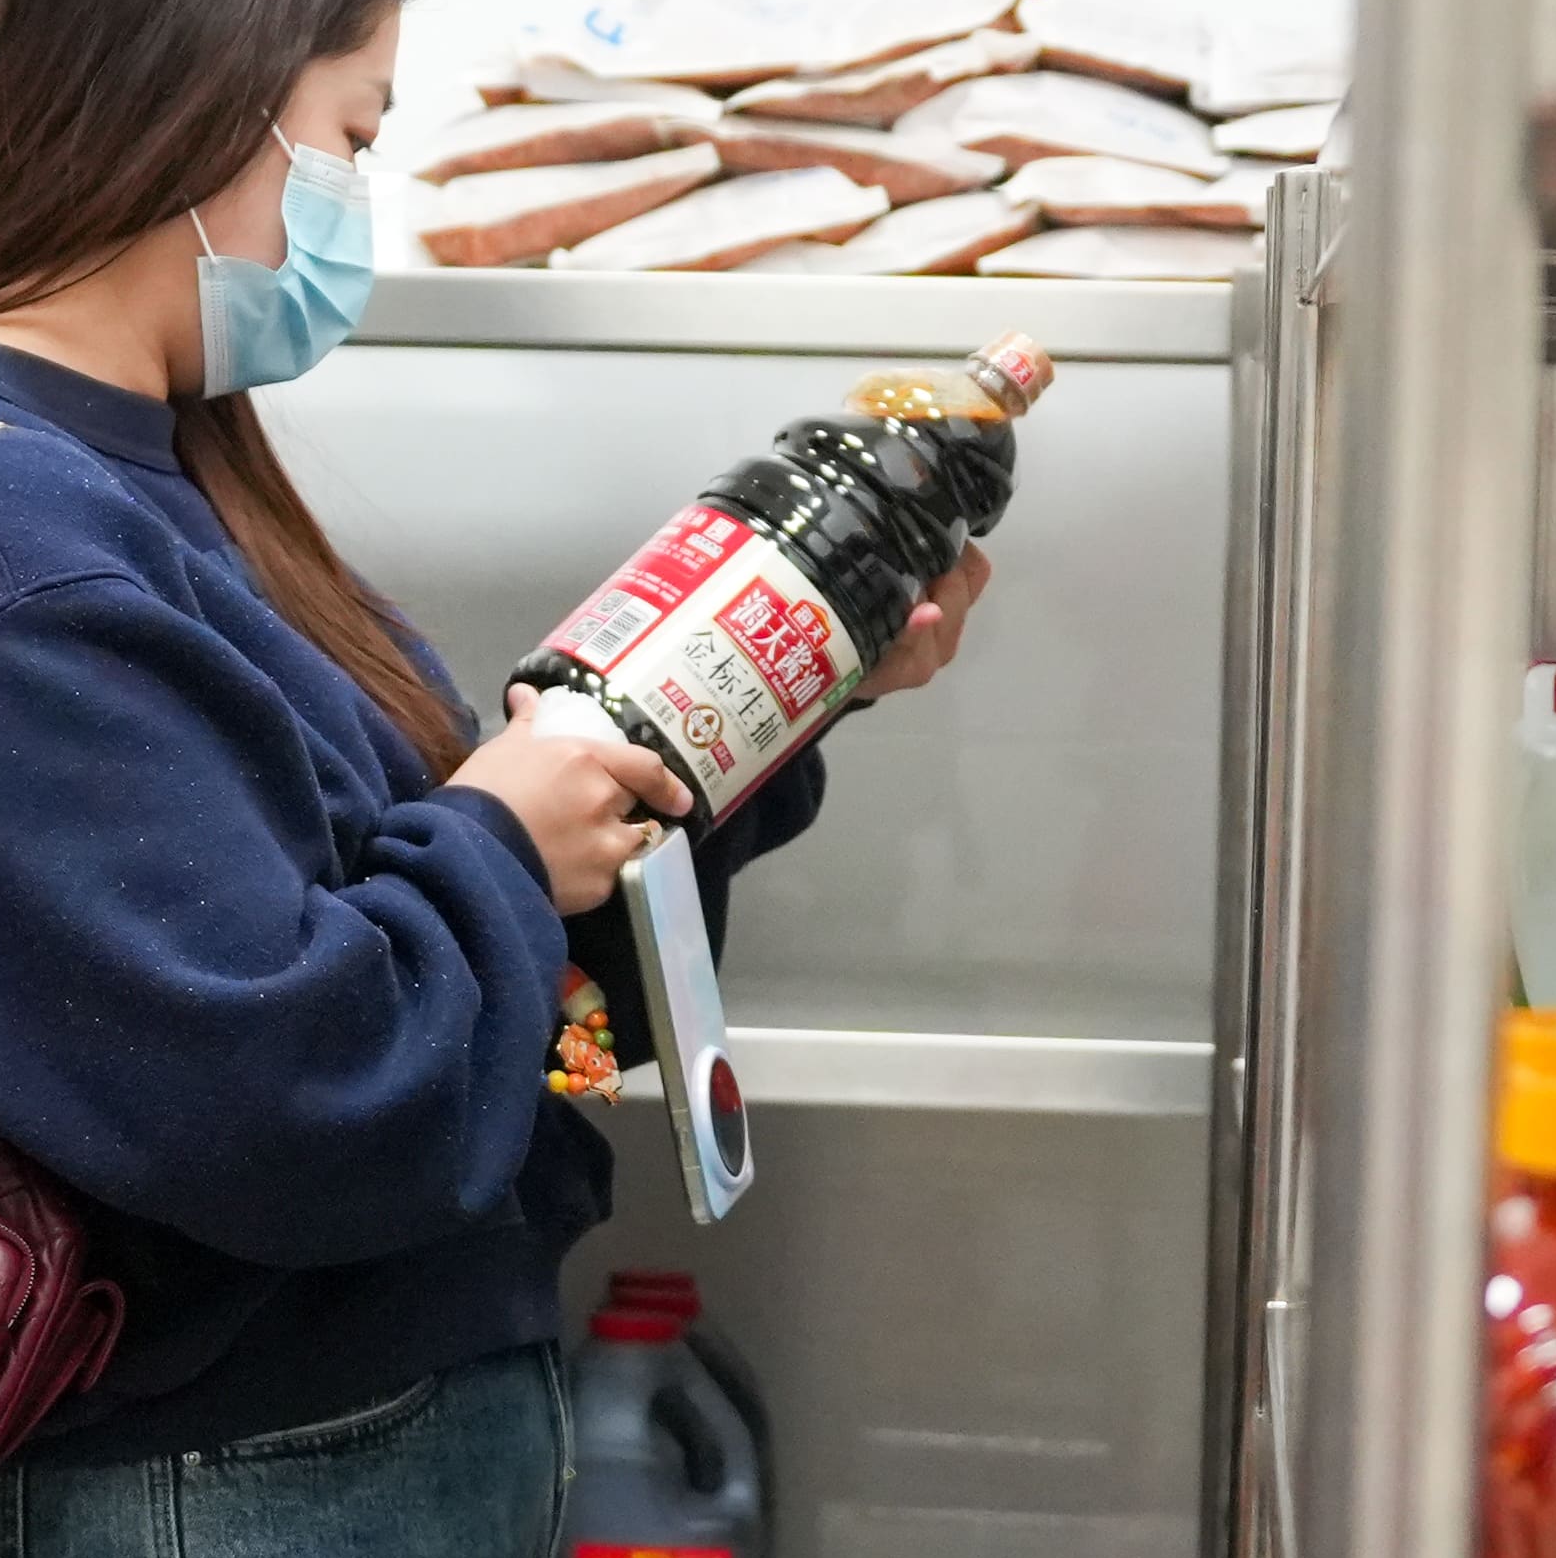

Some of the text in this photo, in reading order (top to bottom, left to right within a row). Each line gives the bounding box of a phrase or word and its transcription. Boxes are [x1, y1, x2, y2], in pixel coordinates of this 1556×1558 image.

[730, 588, 825, 708] 海天酱油
[792, 604, 828, 642] 海天
[685, 631, 782, 753] 金标生抽
